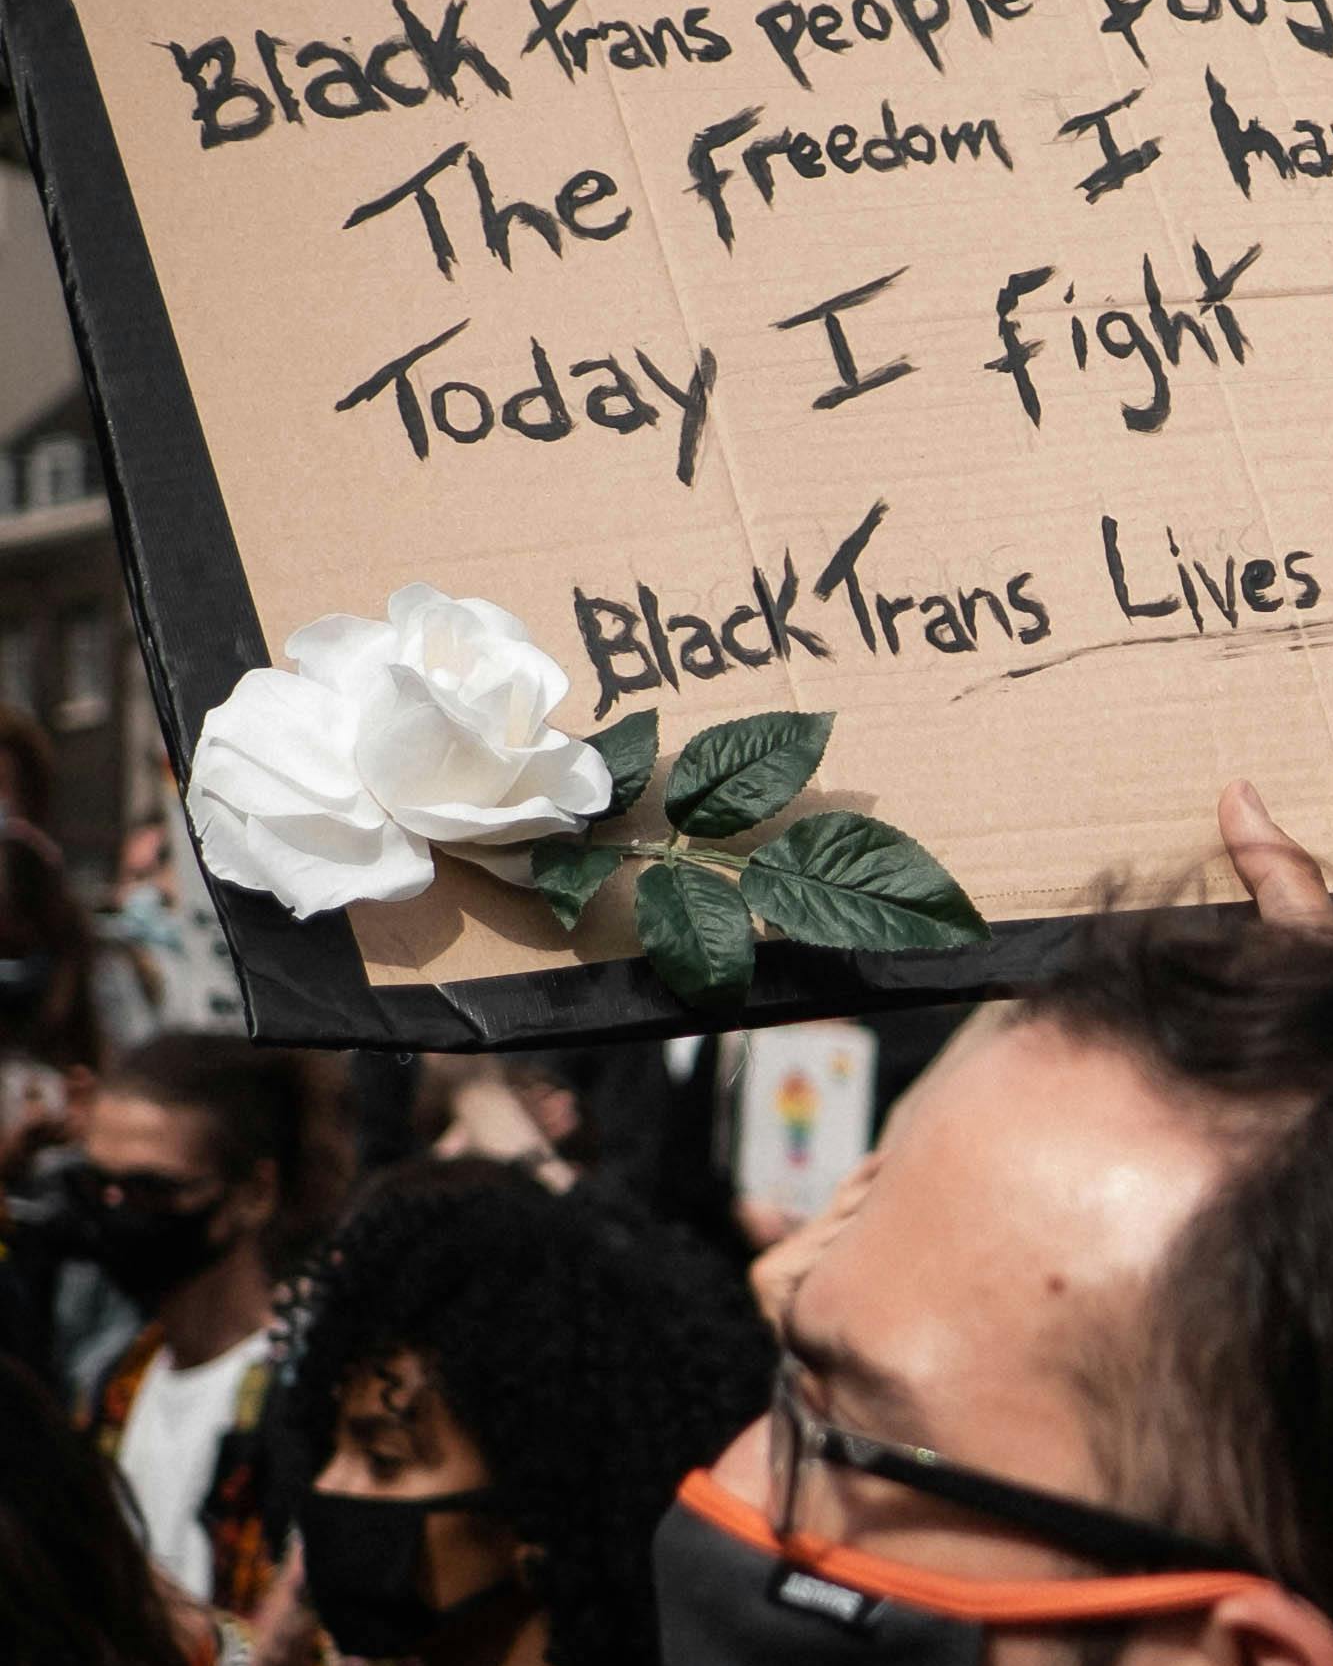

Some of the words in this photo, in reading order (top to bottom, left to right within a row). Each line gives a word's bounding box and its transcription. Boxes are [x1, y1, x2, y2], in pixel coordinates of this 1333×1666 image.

[342, 141, 632, 279] The
[1059, 88, 1162, 203] I
[335, 319, 716, 487] Today
[773, 266, 917, 409] I
[1102, 515, 1321, 631] Lives
